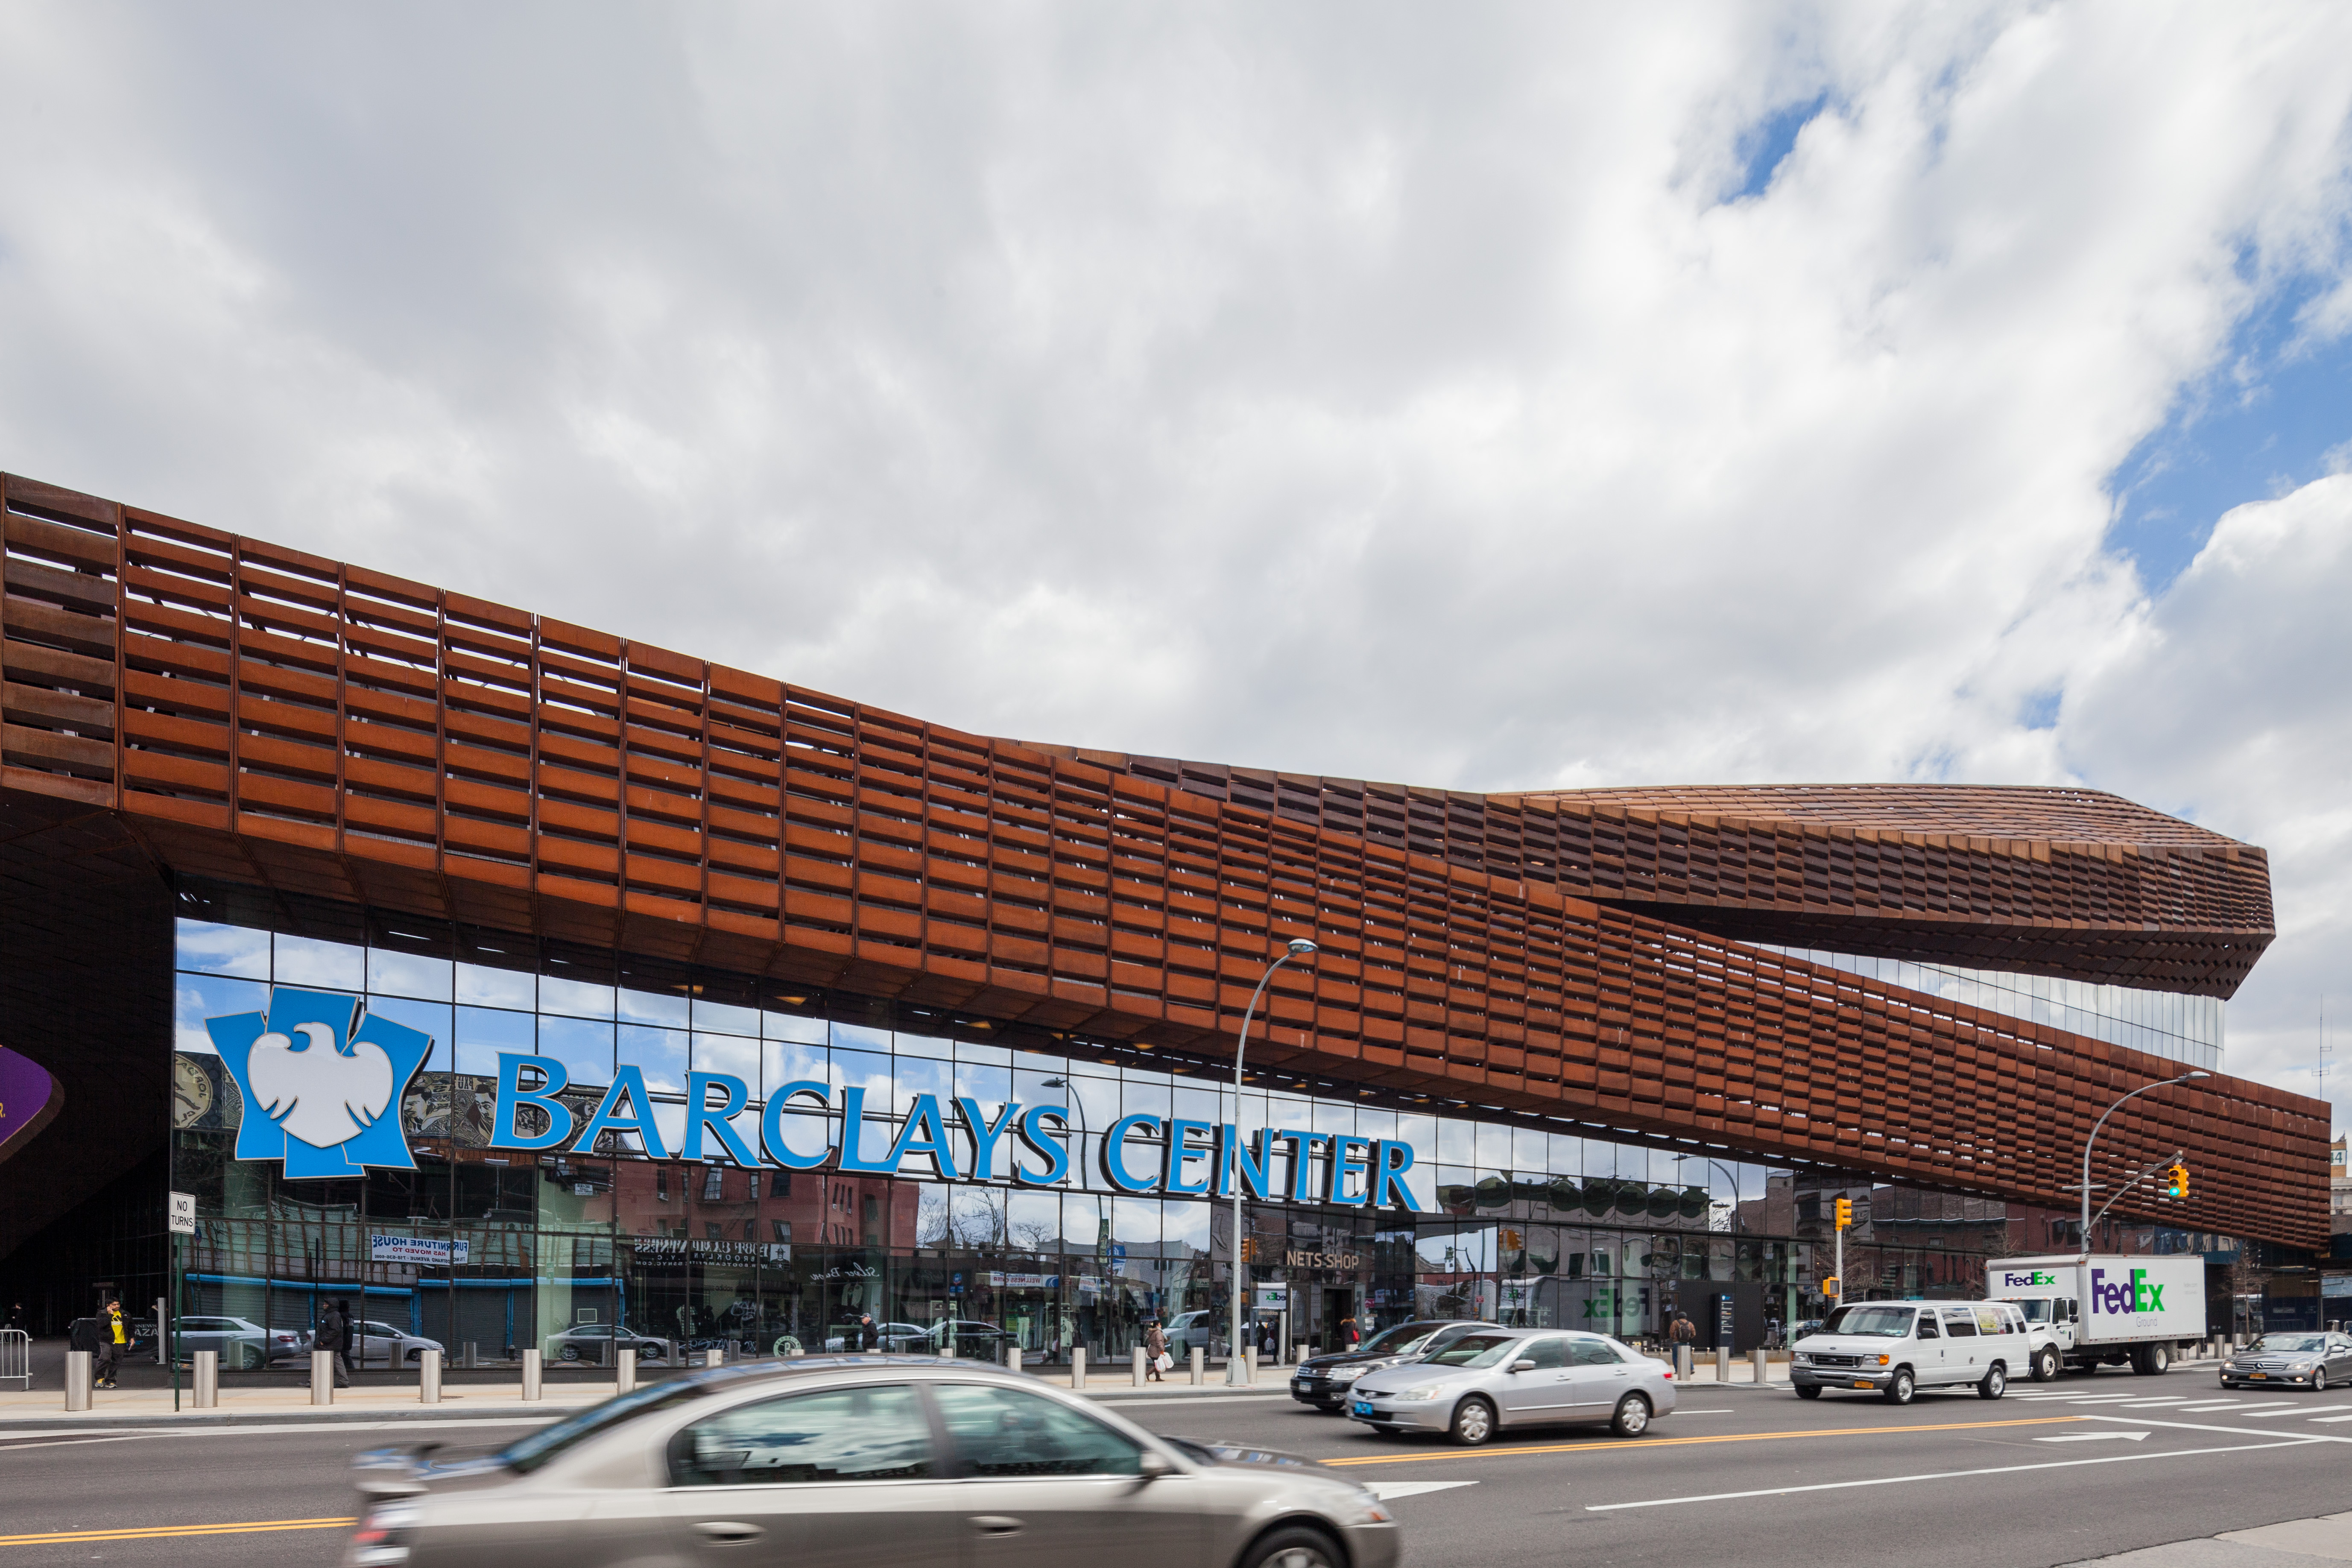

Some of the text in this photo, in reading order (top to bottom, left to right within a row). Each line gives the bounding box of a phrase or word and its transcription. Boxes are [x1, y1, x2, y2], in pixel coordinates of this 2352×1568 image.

[489, 1051, 1423, 1212] BARCLAYS CENTER
[177, 1200, 187, 1211] NO
[171, 1214, 193, 1227] TURNS
[1287, 1250, 1359, 1270] NETS SHOP
[1844, 1277, 1884, 1287] OCAWEAR
[2005, 1271, 2056, 1287] FedEx
[2091, 1269, 2165, 1314] FedEx
[2136, 1316, 2157, 1327] Ground
[135, 1328, 158, 1337] AZA
